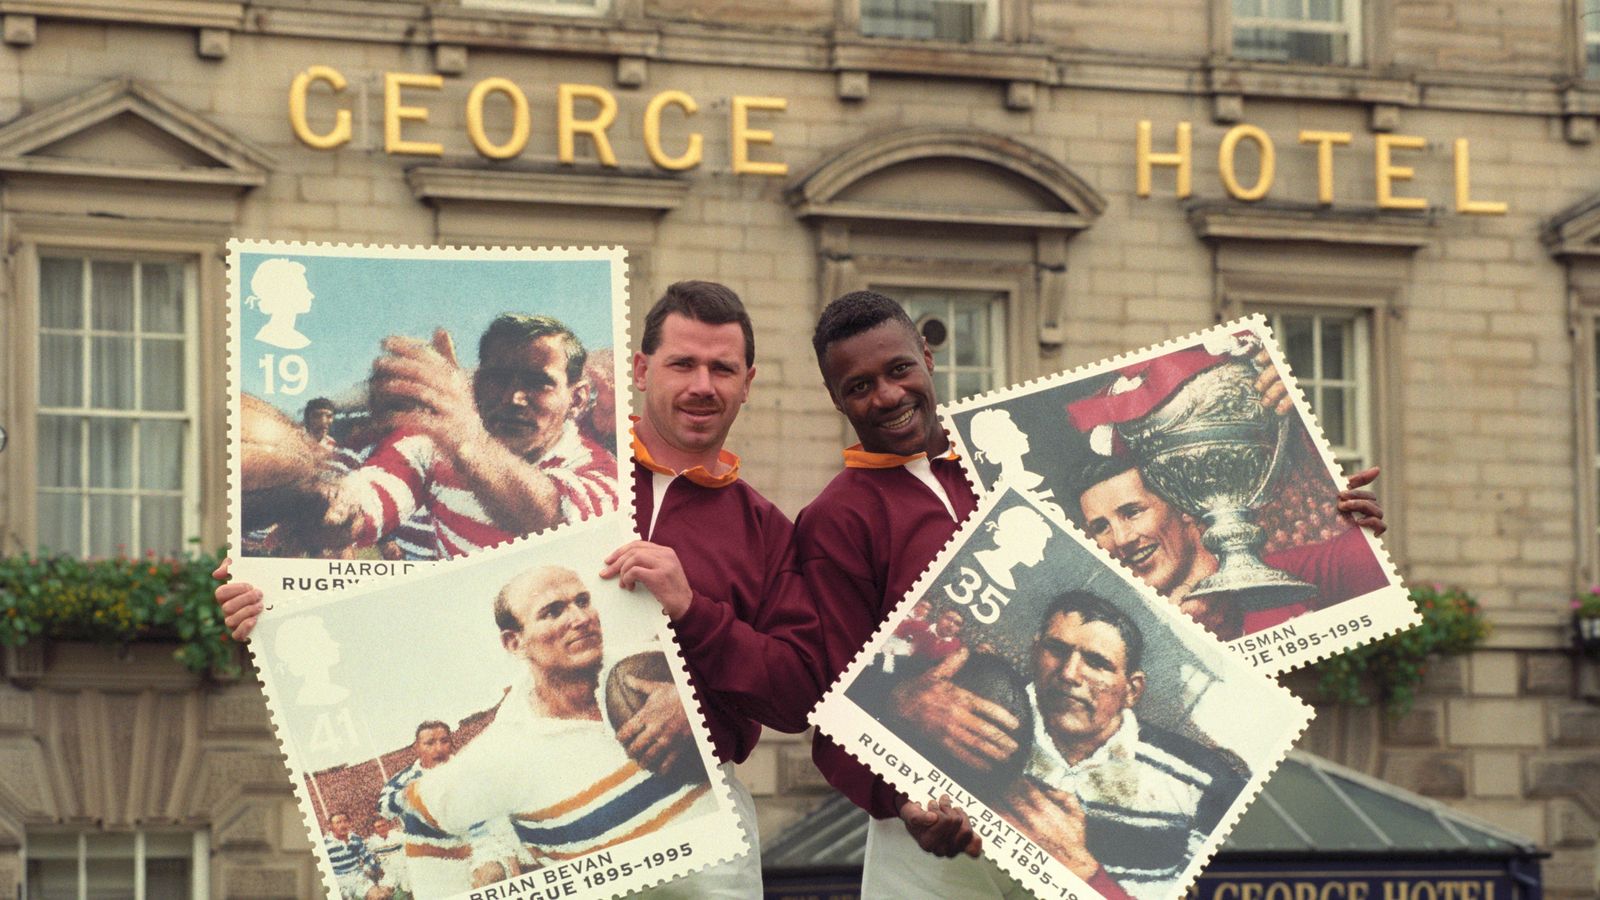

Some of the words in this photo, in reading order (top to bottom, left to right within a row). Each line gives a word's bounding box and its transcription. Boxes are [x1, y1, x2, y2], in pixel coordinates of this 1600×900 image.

[288, 65, 788, 176] GEORGE
[1135, 119, 1508, 214] HOTEL
[259, 354, 308, 395] 19
[943, 567, 1011, 624] 35
[1277, 615, 1373, 657] 1895-1995
[309, 706, 360, 754] 41
[858, 733, 925, 785] RUGBY
[927, 786, 1006, 849] LGUE
[927, 769, 977, 808] BILLY
[980, 809, 1049, 866] BATTEN
[470, 876, 535, 900] BRIAN
[543, 851, 613, 885] BEVAN
[583, 842, 693, 889] 1895-1995
